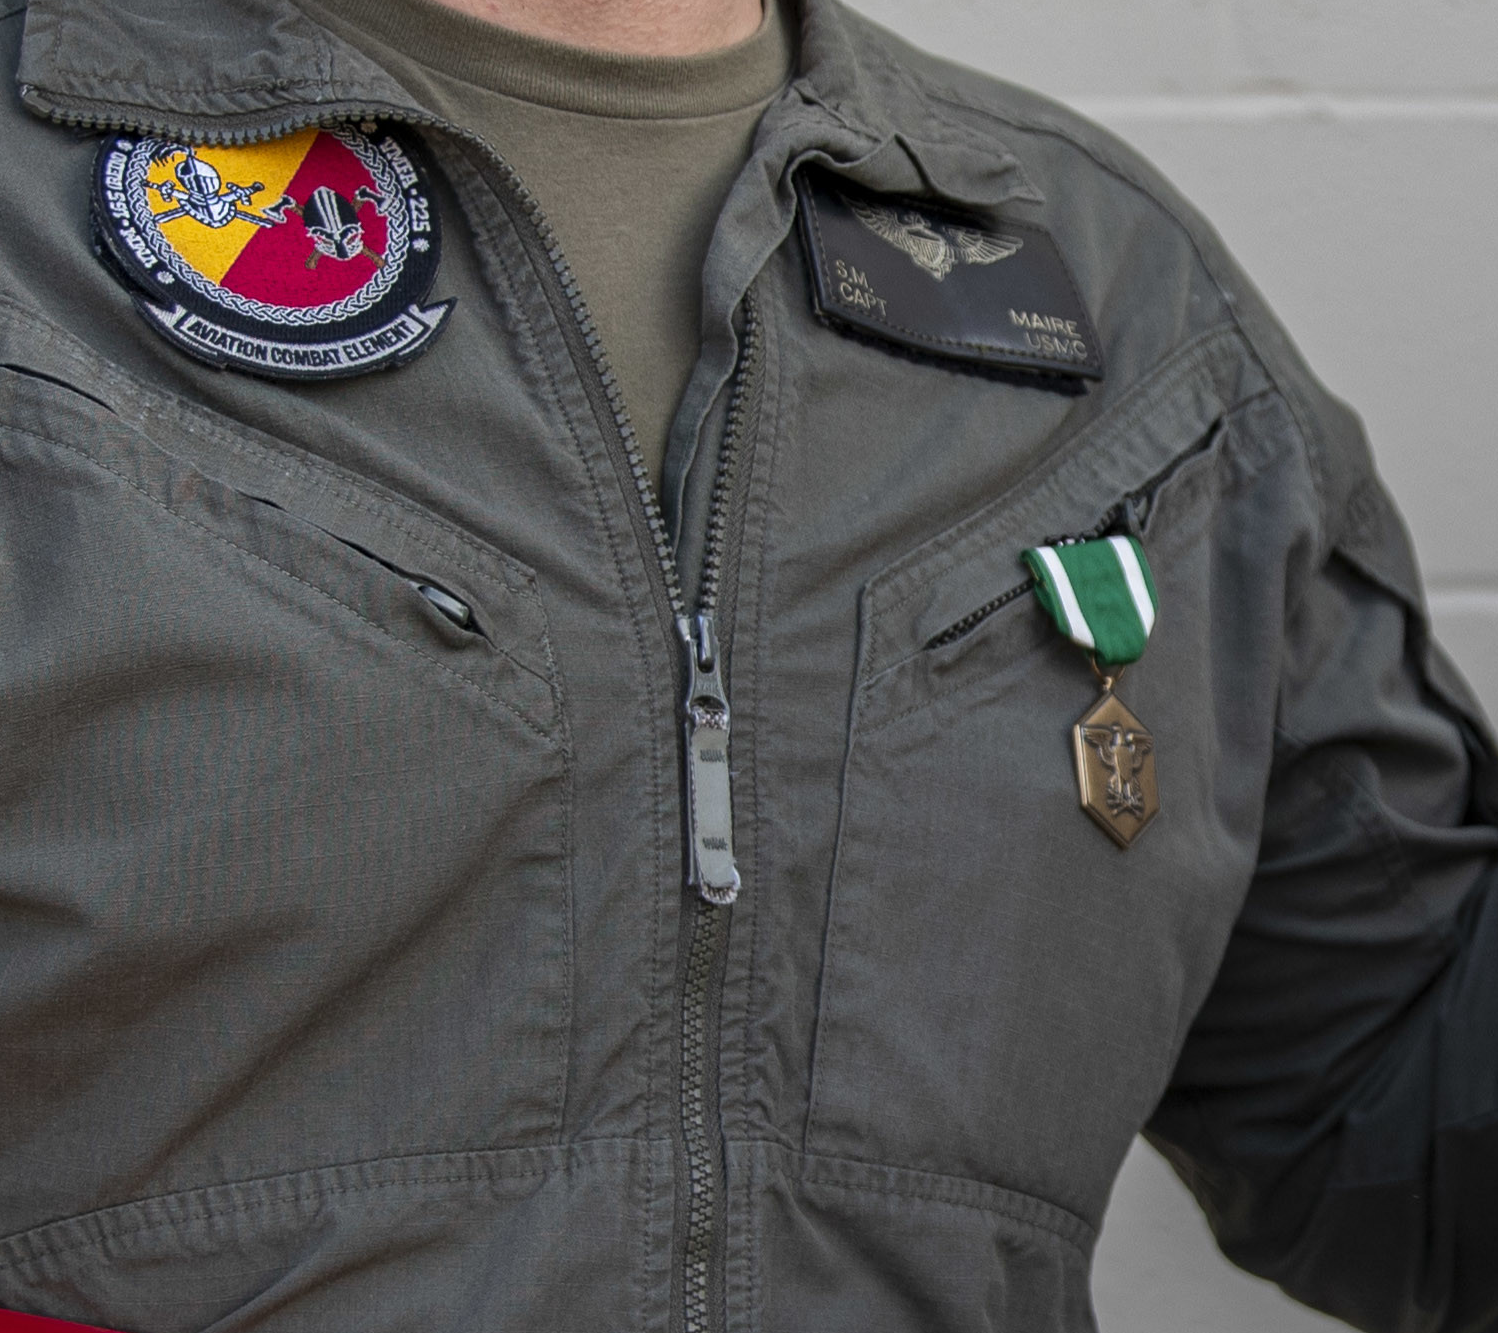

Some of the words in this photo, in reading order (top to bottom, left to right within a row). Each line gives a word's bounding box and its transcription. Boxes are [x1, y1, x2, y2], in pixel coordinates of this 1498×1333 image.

[839, 281, 887, 317] CAPT
[1008, 308, 1082, 339] MAIRE
[188, 319, 267, 361] AVIATION
[271, 347, 343, 367] COMBAT
[344, 320, 415, 361] ELEMENT
[1024, 331, 1088, 360] USMC
